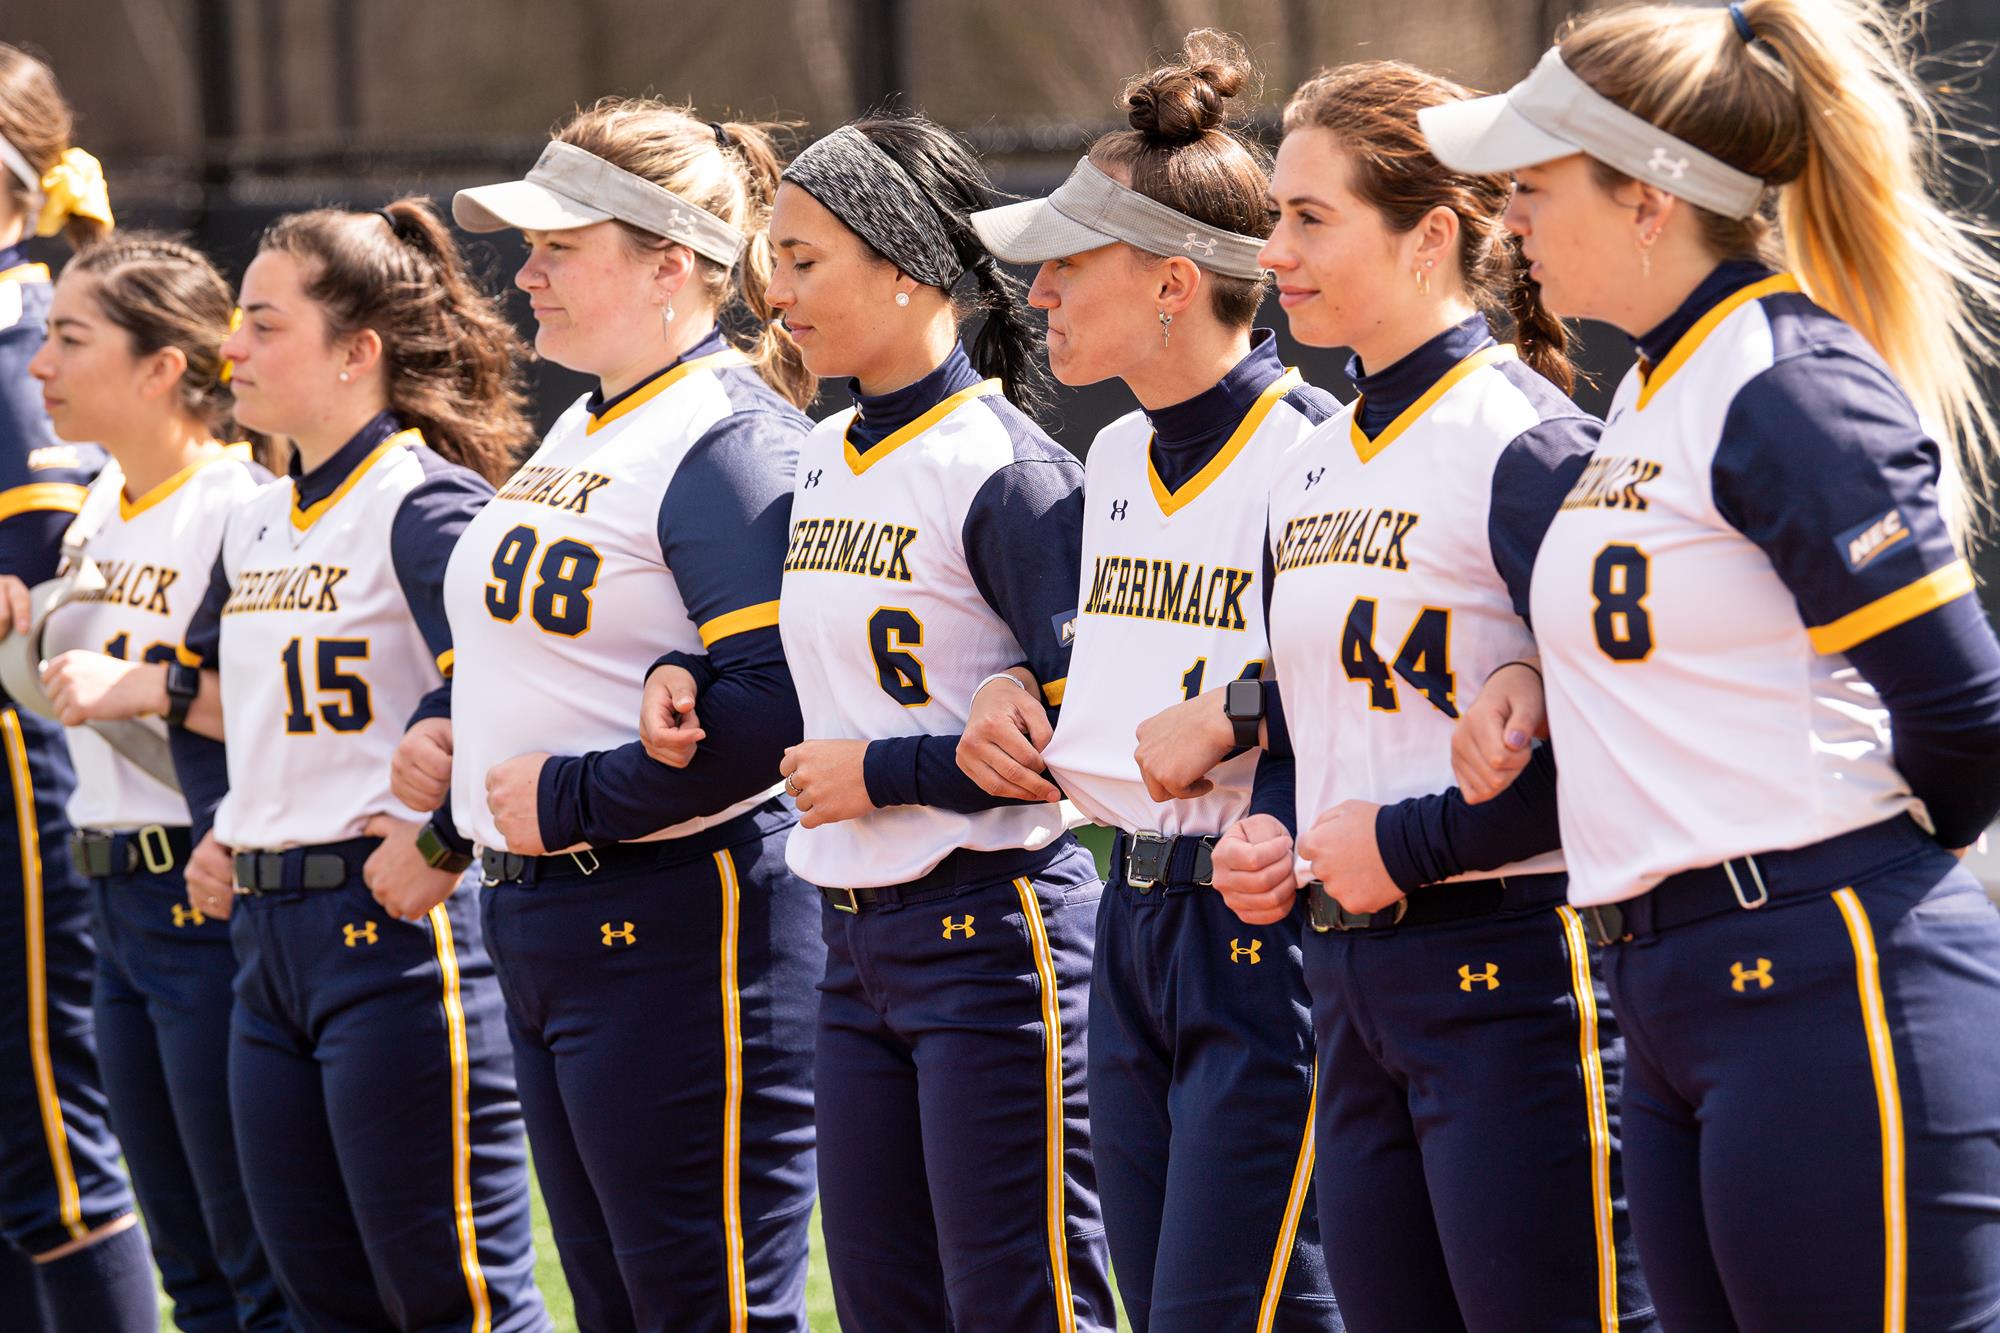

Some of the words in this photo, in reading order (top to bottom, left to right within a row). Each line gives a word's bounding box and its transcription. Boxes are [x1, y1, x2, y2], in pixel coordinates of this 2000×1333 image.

[484, 523, 604, 638] 98
[783, 517, 918, 582] ERRIMACK
[1083, 555, 1254, 632] MERRIMACK
[1590, 540, 1656, 663] 8
[281, 636, 374, 735] 15
[867, 605, 932, 708] 6
[1341, 595, 1463, 720] 44
